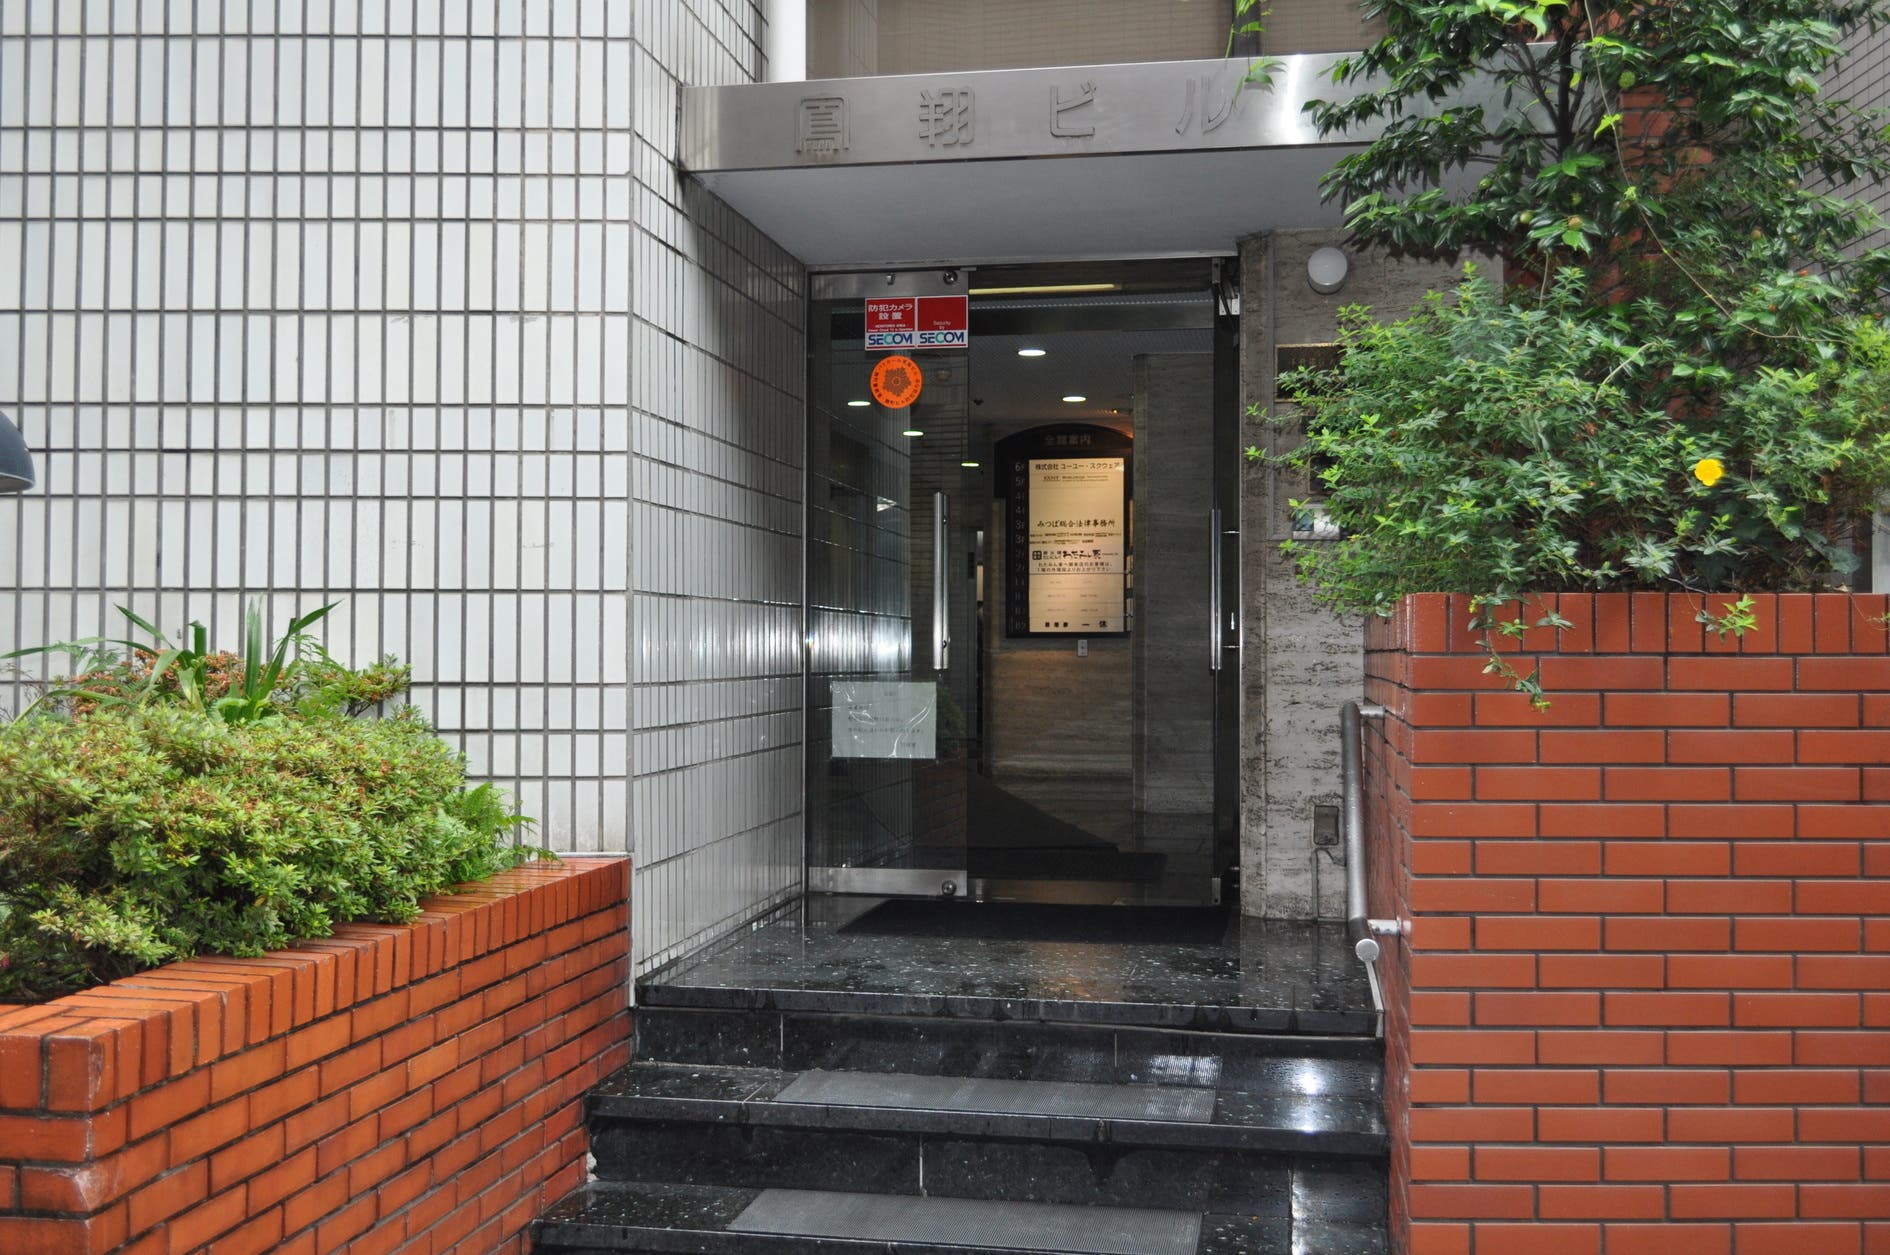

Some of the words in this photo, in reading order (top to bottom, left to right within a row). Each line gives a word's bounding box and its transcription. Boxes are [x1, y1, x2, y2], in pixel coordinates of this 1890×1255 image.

[868, 303, 913, 312] 防犯カメラ
[868, 333, 913, 345] SECOM
[920, 332, 964, 344] SECOM
[1037, 519, 1115, 528] みつば総合法律事務所
